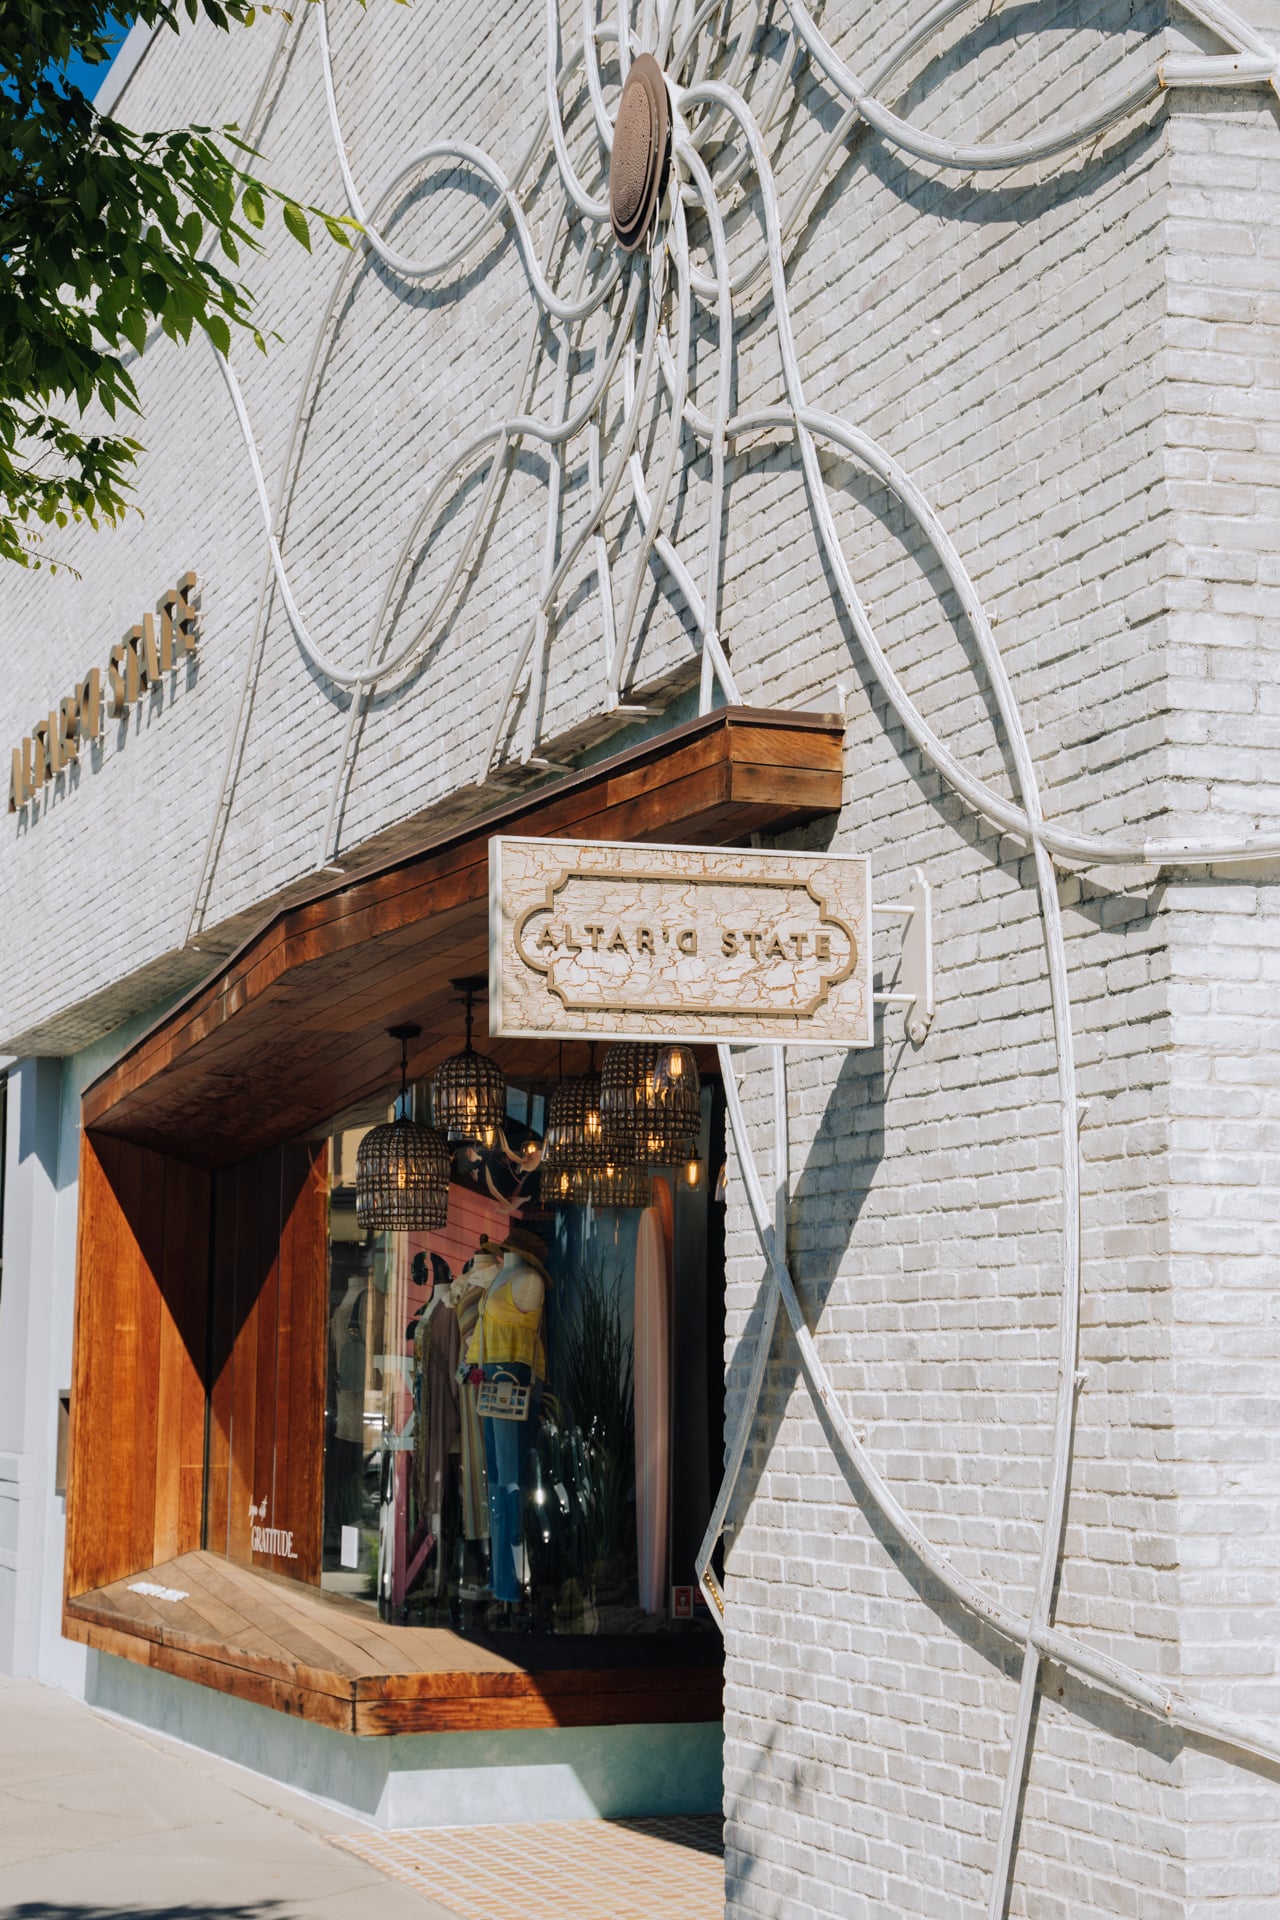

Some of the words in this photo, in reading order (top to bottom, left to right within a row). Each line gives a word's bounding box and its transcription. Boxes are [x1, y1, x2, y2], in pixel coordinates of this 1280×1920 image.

[107, 571, 197, 718] STATE
[535, 923, 698, 956] ALTAR'D
[720, 928, 832, 962] STATE
